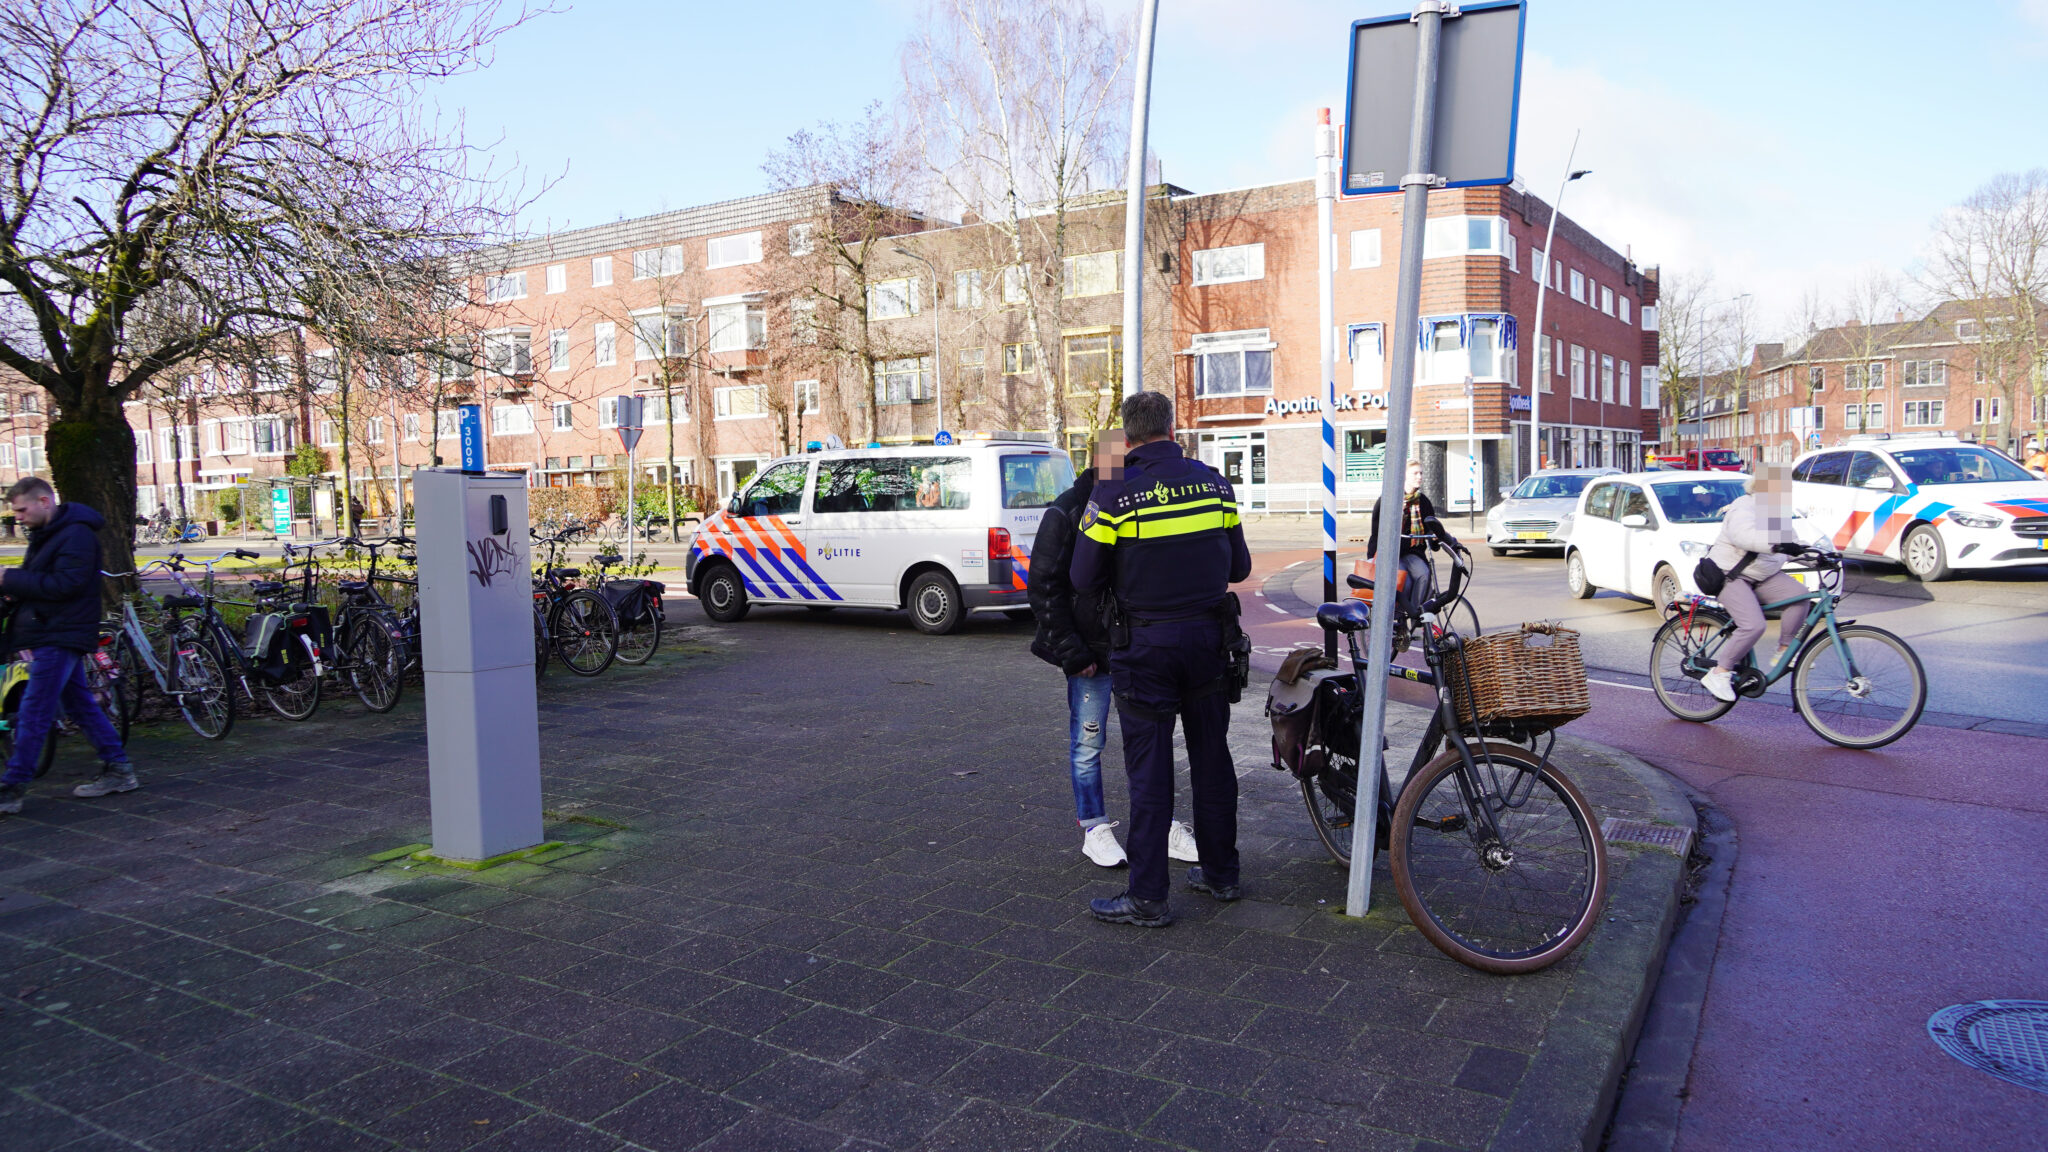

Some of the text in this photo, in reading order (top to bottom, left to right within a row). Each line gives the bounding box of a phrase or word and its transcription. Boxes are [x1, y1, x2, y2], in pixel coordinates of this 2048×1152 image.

[1264, 393, 1353, 416] Apothek
[460, 408, 470, 425] P
[465, 426, 473, 467] 3009
[1145, 481, 1210, 504] POLITIE
[818, 542, 861, 560] POLITIE
